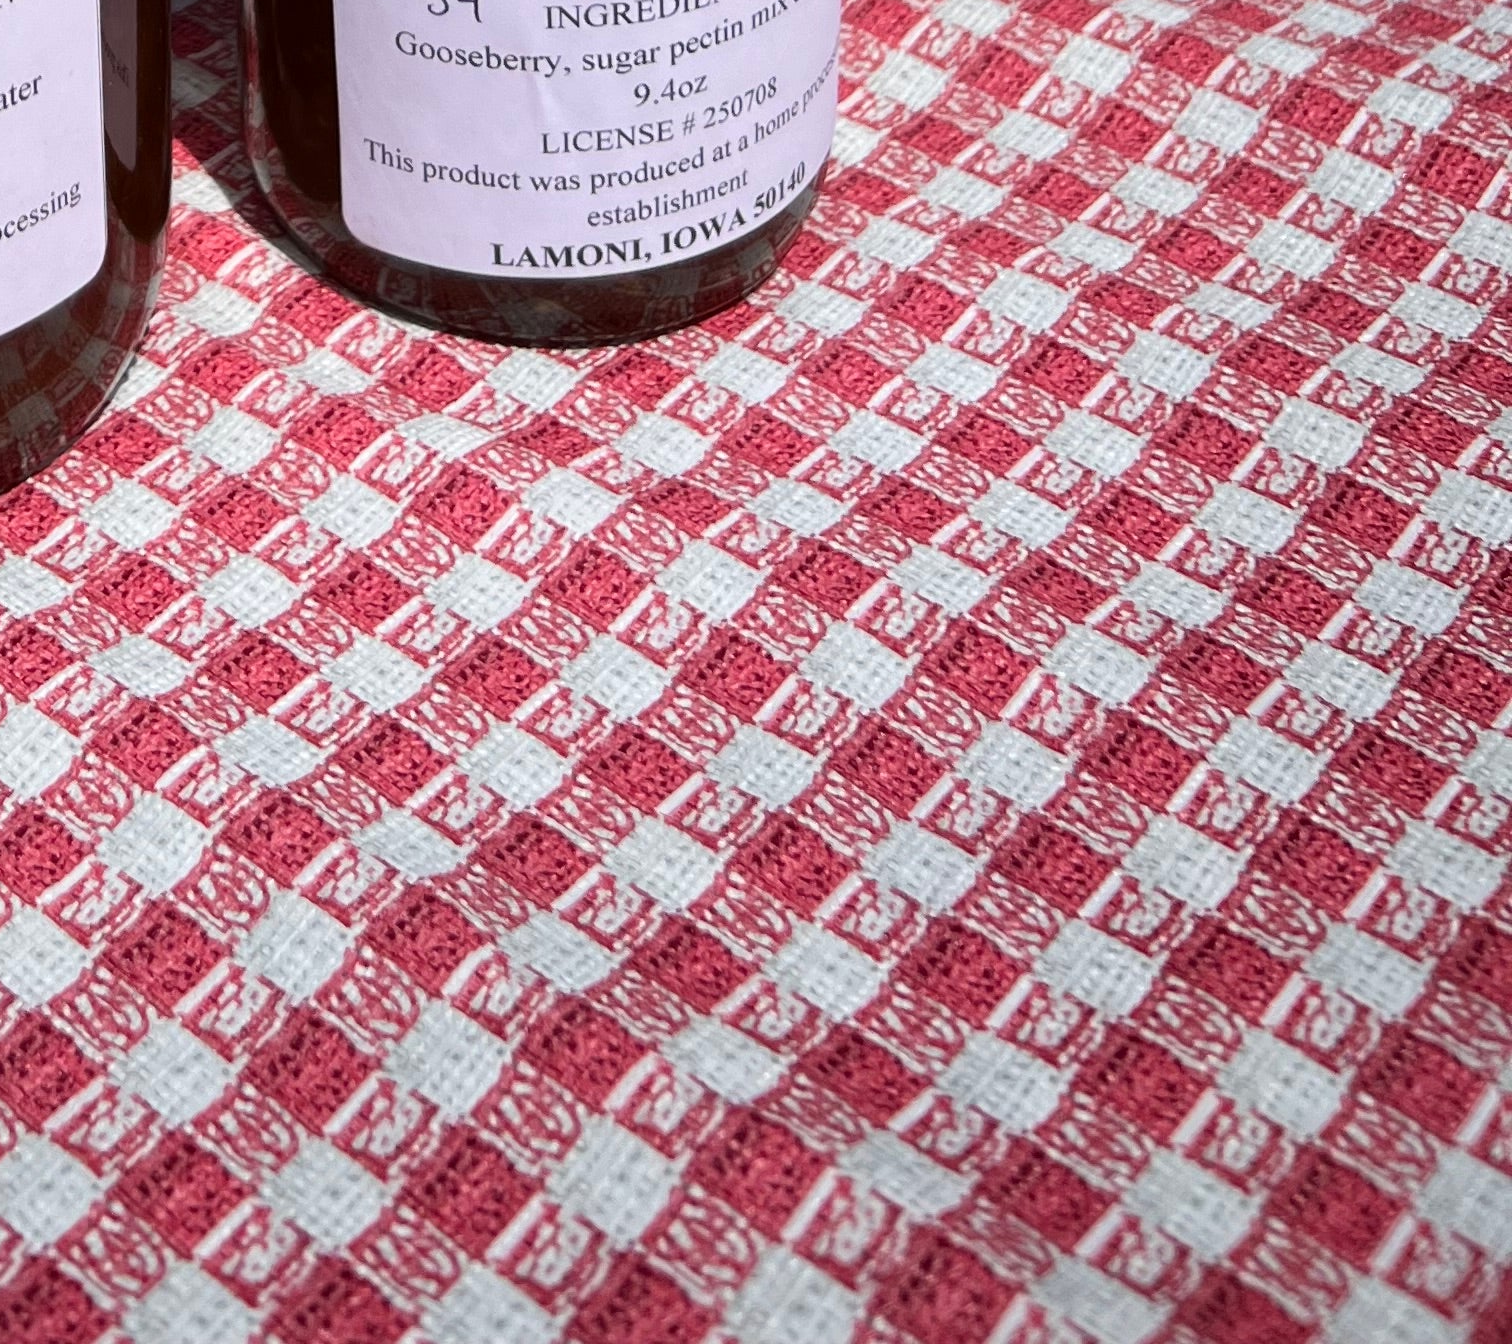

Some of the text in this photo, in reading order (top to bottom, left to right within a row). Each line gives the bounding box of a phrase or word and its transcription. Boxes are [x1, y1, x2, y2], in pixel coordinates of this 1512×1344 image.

[395, 29, 572, 78] Gooseberry,
[581, 45, 661, 75] sugar
[670, 19, 745, 64] pectin
[542, 76, 779, 154] LICENSE # 250708
[633, 73, 708, 107] 9.4oz
[364, 137, 414, 173] This
[422, 160, 521, 192] product
[530, 173, 581, 191] was
[590, 149, 705, 194] produced
[713, 138, 733, 164] at
[738, 134, 749, 150] a
[754, 100, 799, 144] home
[491, 160, 807, 269] LAMONI, IOWA 50140
[587, 168, 750, 228] establishment
